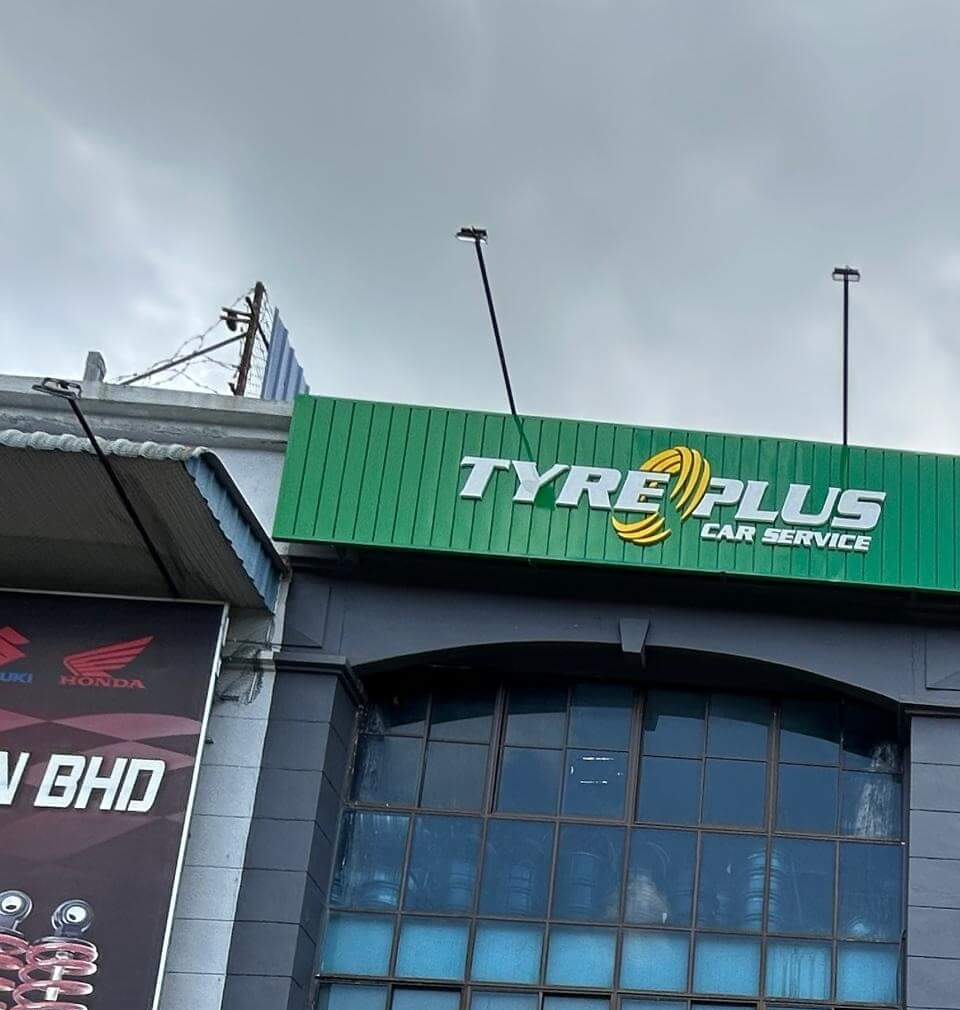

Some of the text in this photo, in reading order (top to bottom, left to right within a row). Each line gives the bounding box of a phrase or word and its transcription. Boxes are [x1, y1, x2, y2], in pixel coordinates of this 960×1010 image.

[701, 522, 872, 552] CAR SERVICE
[59, 675, 146, 689] HONDA
[33, 754, 166, 813] BHD
